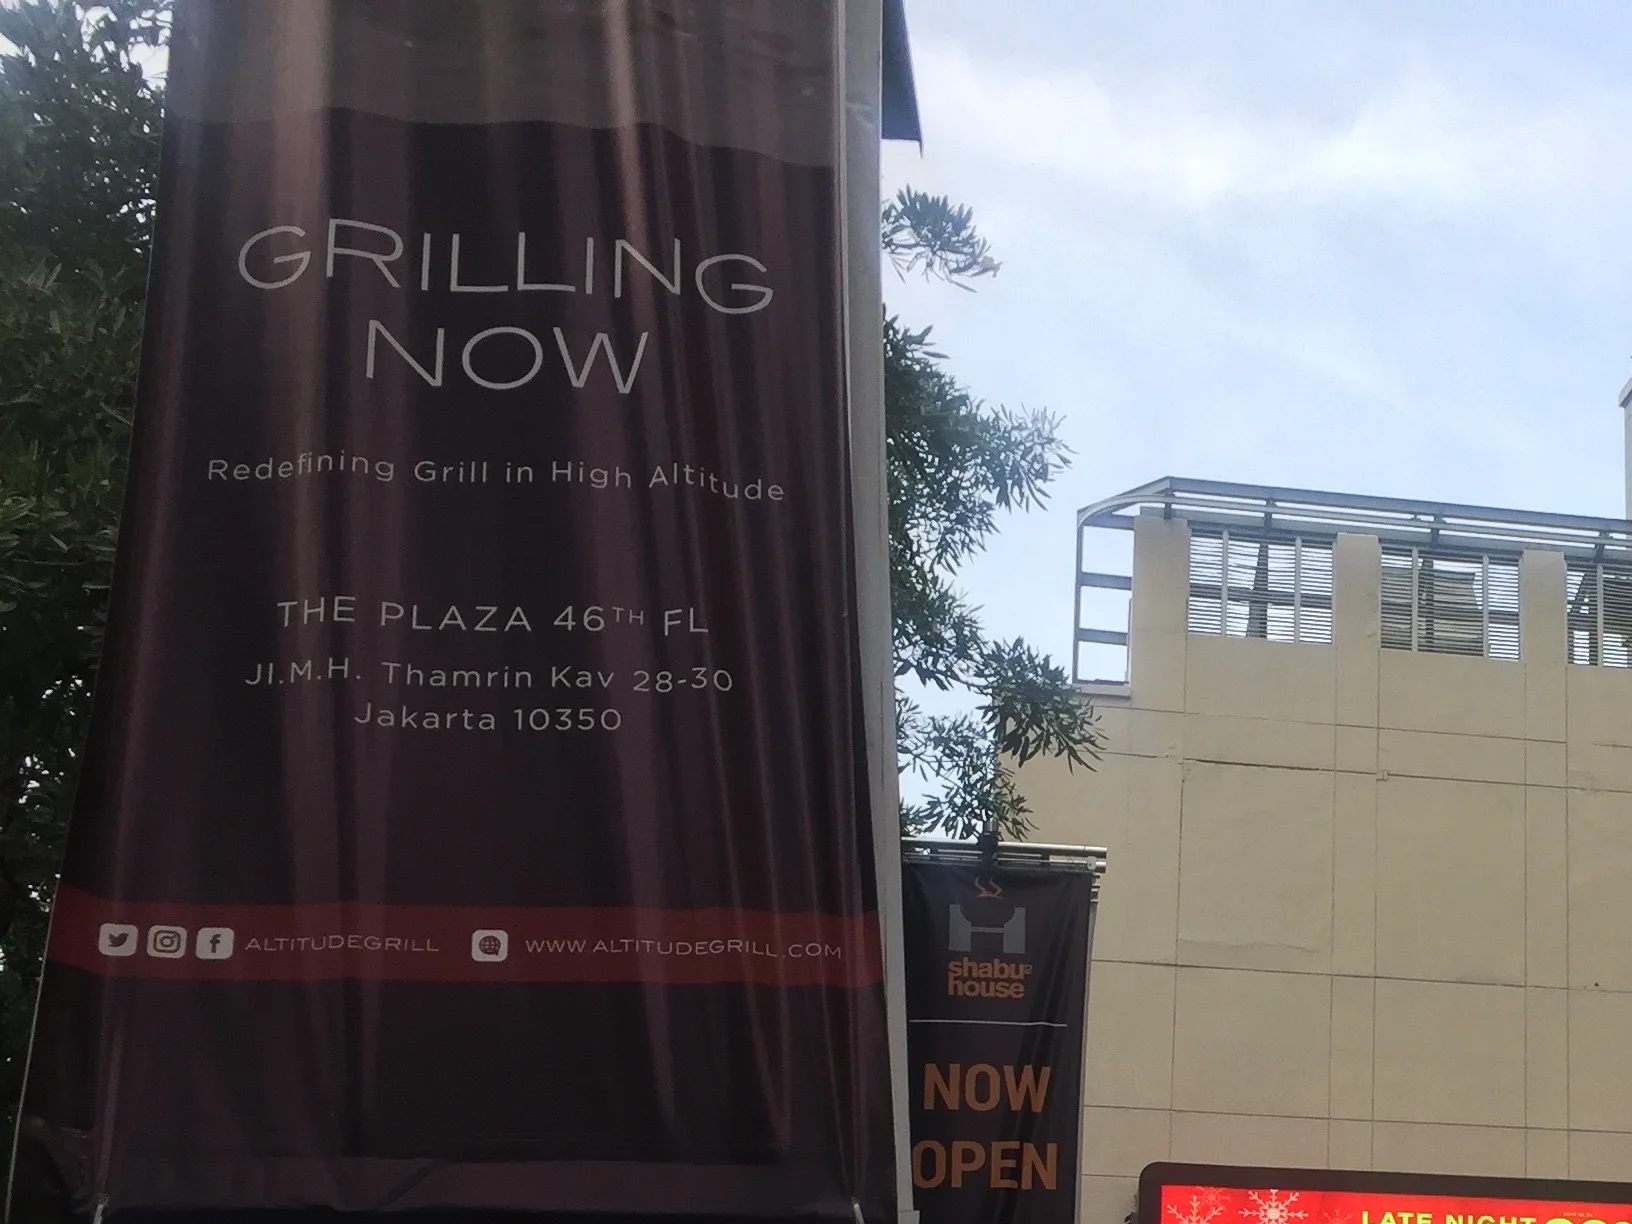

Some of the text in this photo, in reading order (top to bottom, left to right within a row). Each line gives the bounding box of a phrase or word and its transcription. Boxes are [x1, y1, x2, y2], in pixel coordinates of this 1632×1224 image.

[237, 218, 776, 315] GRILLING
[365, 318, 650, 395] NOW
[206, 449, 786, 502] Redefining Grill in High Altitude
[277, 596, 357, 627] THE
[380, 601, 532, 632] PLAZA
[663, 608, 708, 635] FL
[381, 661, 532, 688] Thamrin
[551, 666, 615, 689] Kav
[633, 666, 733, 693] 28-30
[354, 703, 622, 731] Jakarta 10350
[245, 934, 440, 953] ALTITUDEGRILL
[948, 972, 1025, 998] house
[923, 1062, 1051, 1113] NOW
[913, 1139, 1058, 1191] OPEN
